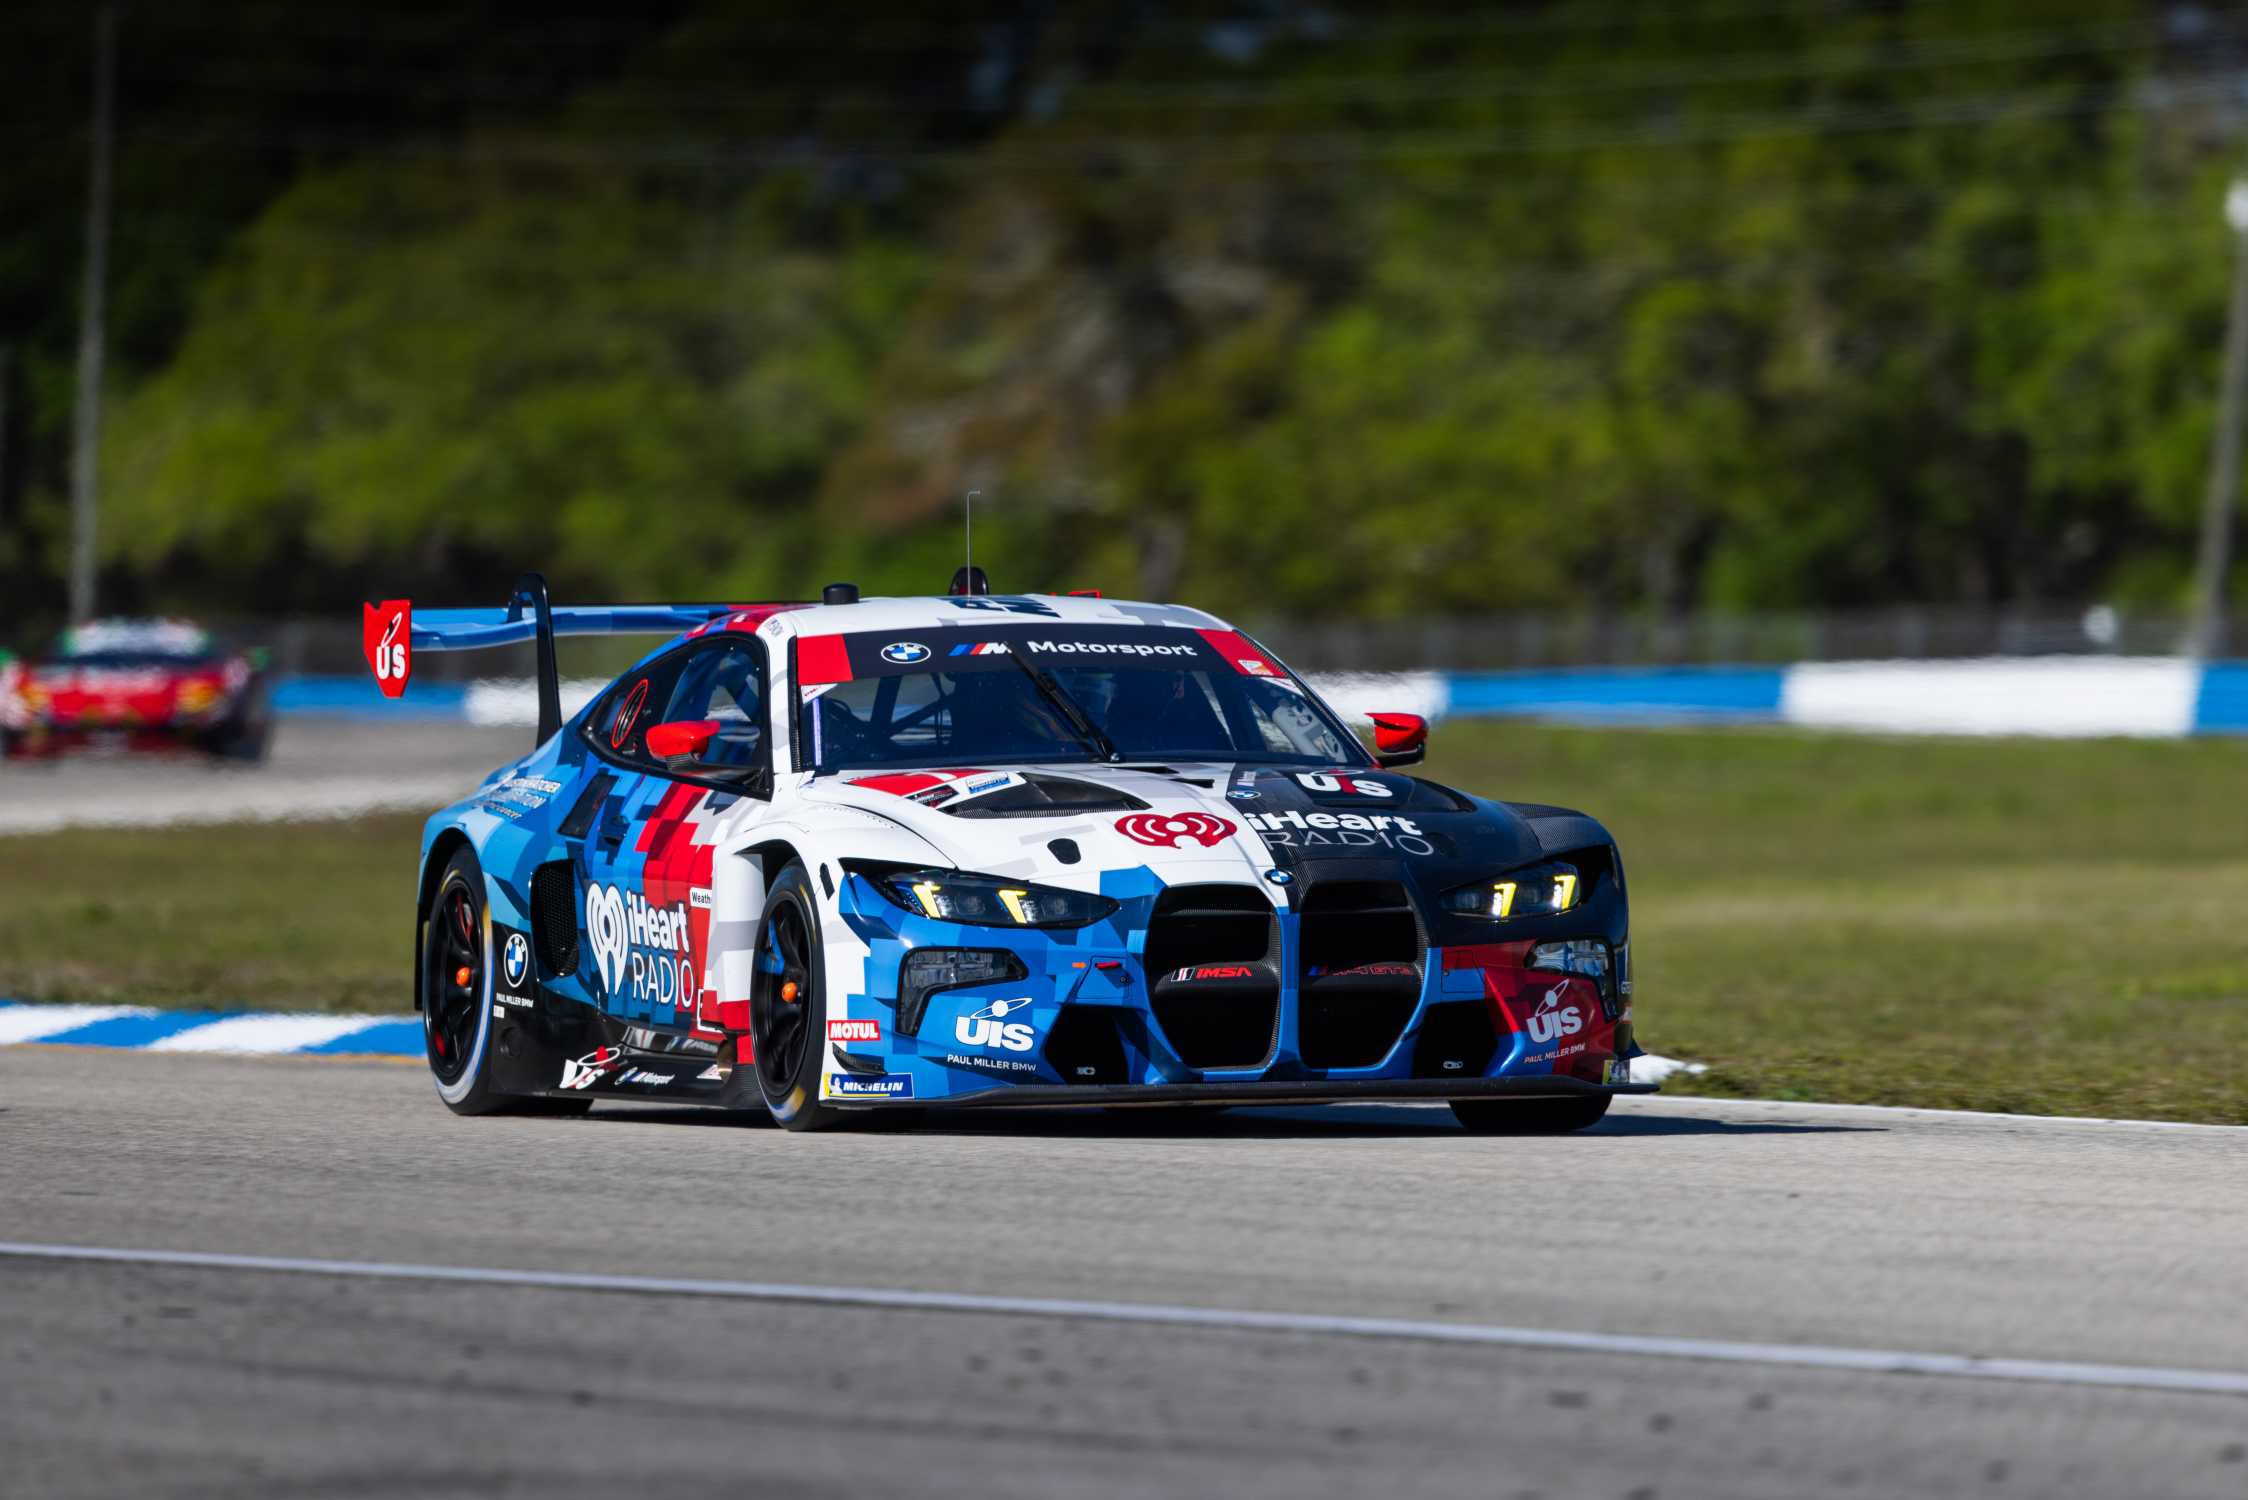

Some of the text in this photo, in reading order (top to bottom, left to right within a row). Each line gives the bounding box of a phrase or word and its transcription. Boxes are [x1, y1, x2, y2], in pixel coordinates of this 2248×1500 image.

[1027, 641, 1198, 656] Motorsport
[1295, 773, 1393, 798] UIS
[1242, 810, 1423, 836] iHeart
[1258, 831, 1434, 856] RADIO
[626, 889, 690, 953] iHeart
[632, 951, 694, 1008] RADIO
[1196, 967, 1252, 979] IMSA
[830, 1023, 878, 1039] MOTUL
[955, 1016, 1035, 1052] UIS
[1526, 1006, 1583, 1043] UIS
[947, 1054, 1037, 1072] PAUL MILLER BMW
[1544, 1047, 1570, 1061] MILLER
[843, 1081, 904, 1092] MICHELIN
